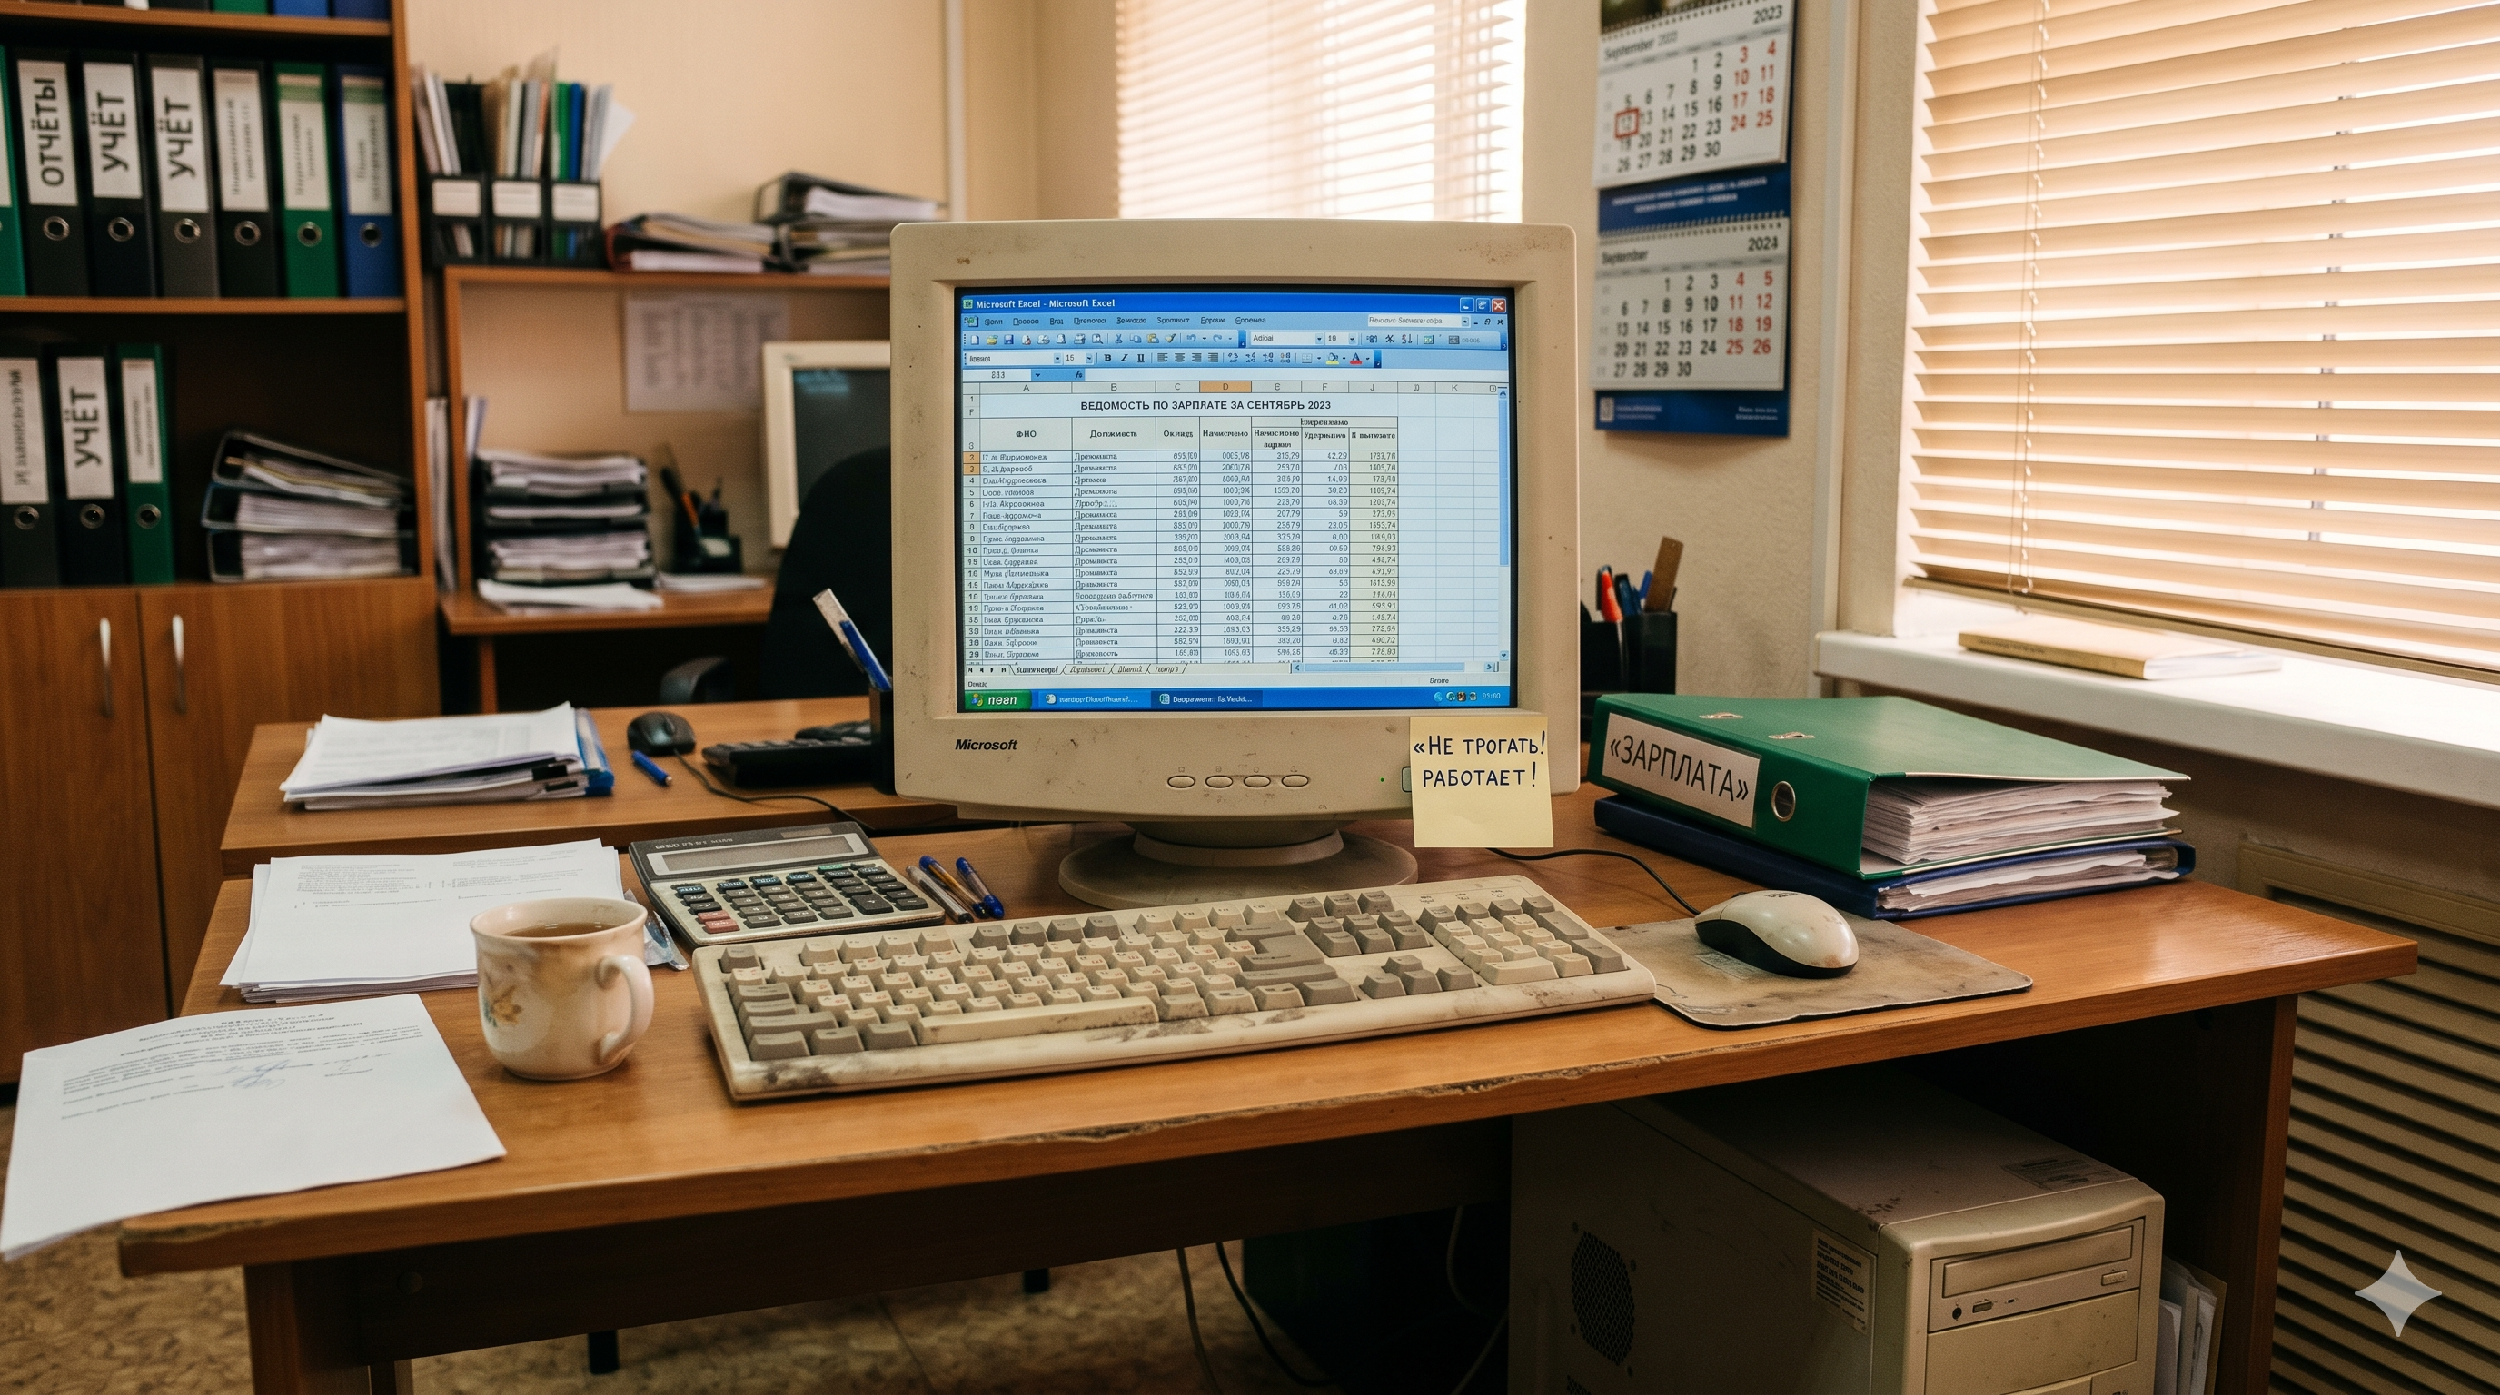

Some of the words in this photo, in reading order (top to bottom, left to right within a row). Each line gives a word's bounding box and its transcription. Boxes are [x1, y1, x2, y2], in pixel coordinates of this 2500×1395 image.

[1753, 5, 1783, 25] 2023
[1692, 57, 1698, 72] 1
[1715, 52, 1722, 68] 2
[1740, 46, 1748, 63] 3
[1768, 40, 1776, 54] 4
[1646, 89, 1652, 105] 6
[1667, 84, 1674, 100] 7
[1690, 79, 1698, 95] 8
[1714, 74, 1722, 91] 9
[1735, 69, 1749, 85] 10
[1761, 64, 1774, 81] 11
[1621, 116, 1632, 131] 12
[1641, 111, 1653, 125] 13
[1662, 106, 1675, 121] 14
[1684, 102, 1698, 117] 15
[1708, 97, 1722, 114] 16
[1733, 92, 1748, 108] 17
[1760, 86, 1774, 104] 18
[31, 77, 65, 186] ОТЧЁТЫ
[92, 93, 129, 172] УЧЁТ
[159, 98, 195, 179] УЧЁТ
[1638, 133, 1652, 148] 20
[1659, 127, 1673, 144] 21
[1682, 124, 1697, 141] 22
[1705, 119, 1721, 136] 23
[1731, 114, 1746, 132] 24
[1756, 111, 1773, 128] 25
[1617, 157, 1630, 173] 26
[1638, 153, 1652, 169] 27
[1658, 149, 1672, 165] 28
[1681, 145, 1696, 161] 29
[1704, 141, 1721, 158] 30
[1748, 236, 1779, 252] 2024
[1665, 278, 1670, 292] 1
[1686, 275, 1693, 291] 2
[1711, 274, 1718, 289] 3
[1736, 272, 1744, 286] 4
[1764, 271, 1772, 286] 5
[1092, 299, 1115, 307] Excel
[1621, 302, 1628, 315] 6
[1642, 300, 1648, 314] 7
[1662, 298, 1670, 313] 8
[1685, 297, 1693, 312] 9
[1704, 296, 1718, 312] 10
[1730, 294, 1743, 310] 11
[1757, 293, 1772, 309] 12
[1617, 322, 1628, 336] 13
[1637, 321, 1649, 335] 14
[1658, 320, 1670, 335] 15
[1680, 320, 1693, 334] 16
[1703, 318, 1717, 333] 17
[1728, 317, 1743, 332] 18
[1756, 316, 1772, 332] 19
[1614, 342, 1628, 357] 20
[1634, 341, 1647, 356] 21
[1655, 340, 1669, 356] 22
[1678, 340, 1692, 355] 23
[1701, 340, 1716, 355] 24
[1726, 339, 1743, 355] 25
[1753, 339, 1771, 355] 26
[1614, 362, 1626, 377] 27
[1633, 362, 1647, 377] 28
[1654, 361, 1669, 377] 29
[1678, 361, 1691, 377] 30
[1023, 384, 1030, 392] A
[1175, 383, 1181, 391] C
[1223, 383, 1229, 391] D
[1322, 383, 1328, 391] F
[1081, 401, 1150, 411] ВЕДОМОСТЬ
[1153, 401, 1168, 410] ПО
[1231, 401, 1244, 410] ЗА
[1247, 400, 1305, 410] СЕНТЯБРЬ
[1308, 400, 1331, 410] 2023
[64, 387, 102, 468] УЧЁТ
[956, 739, 1018, 750] Microsoft
[1414, 735, 1453, 755] «НЕ
[1463, 730, 1545, 755] ТРОГАТЬ!
[1611, 735, 1749, 801] «ЗАРПЛАТА»
